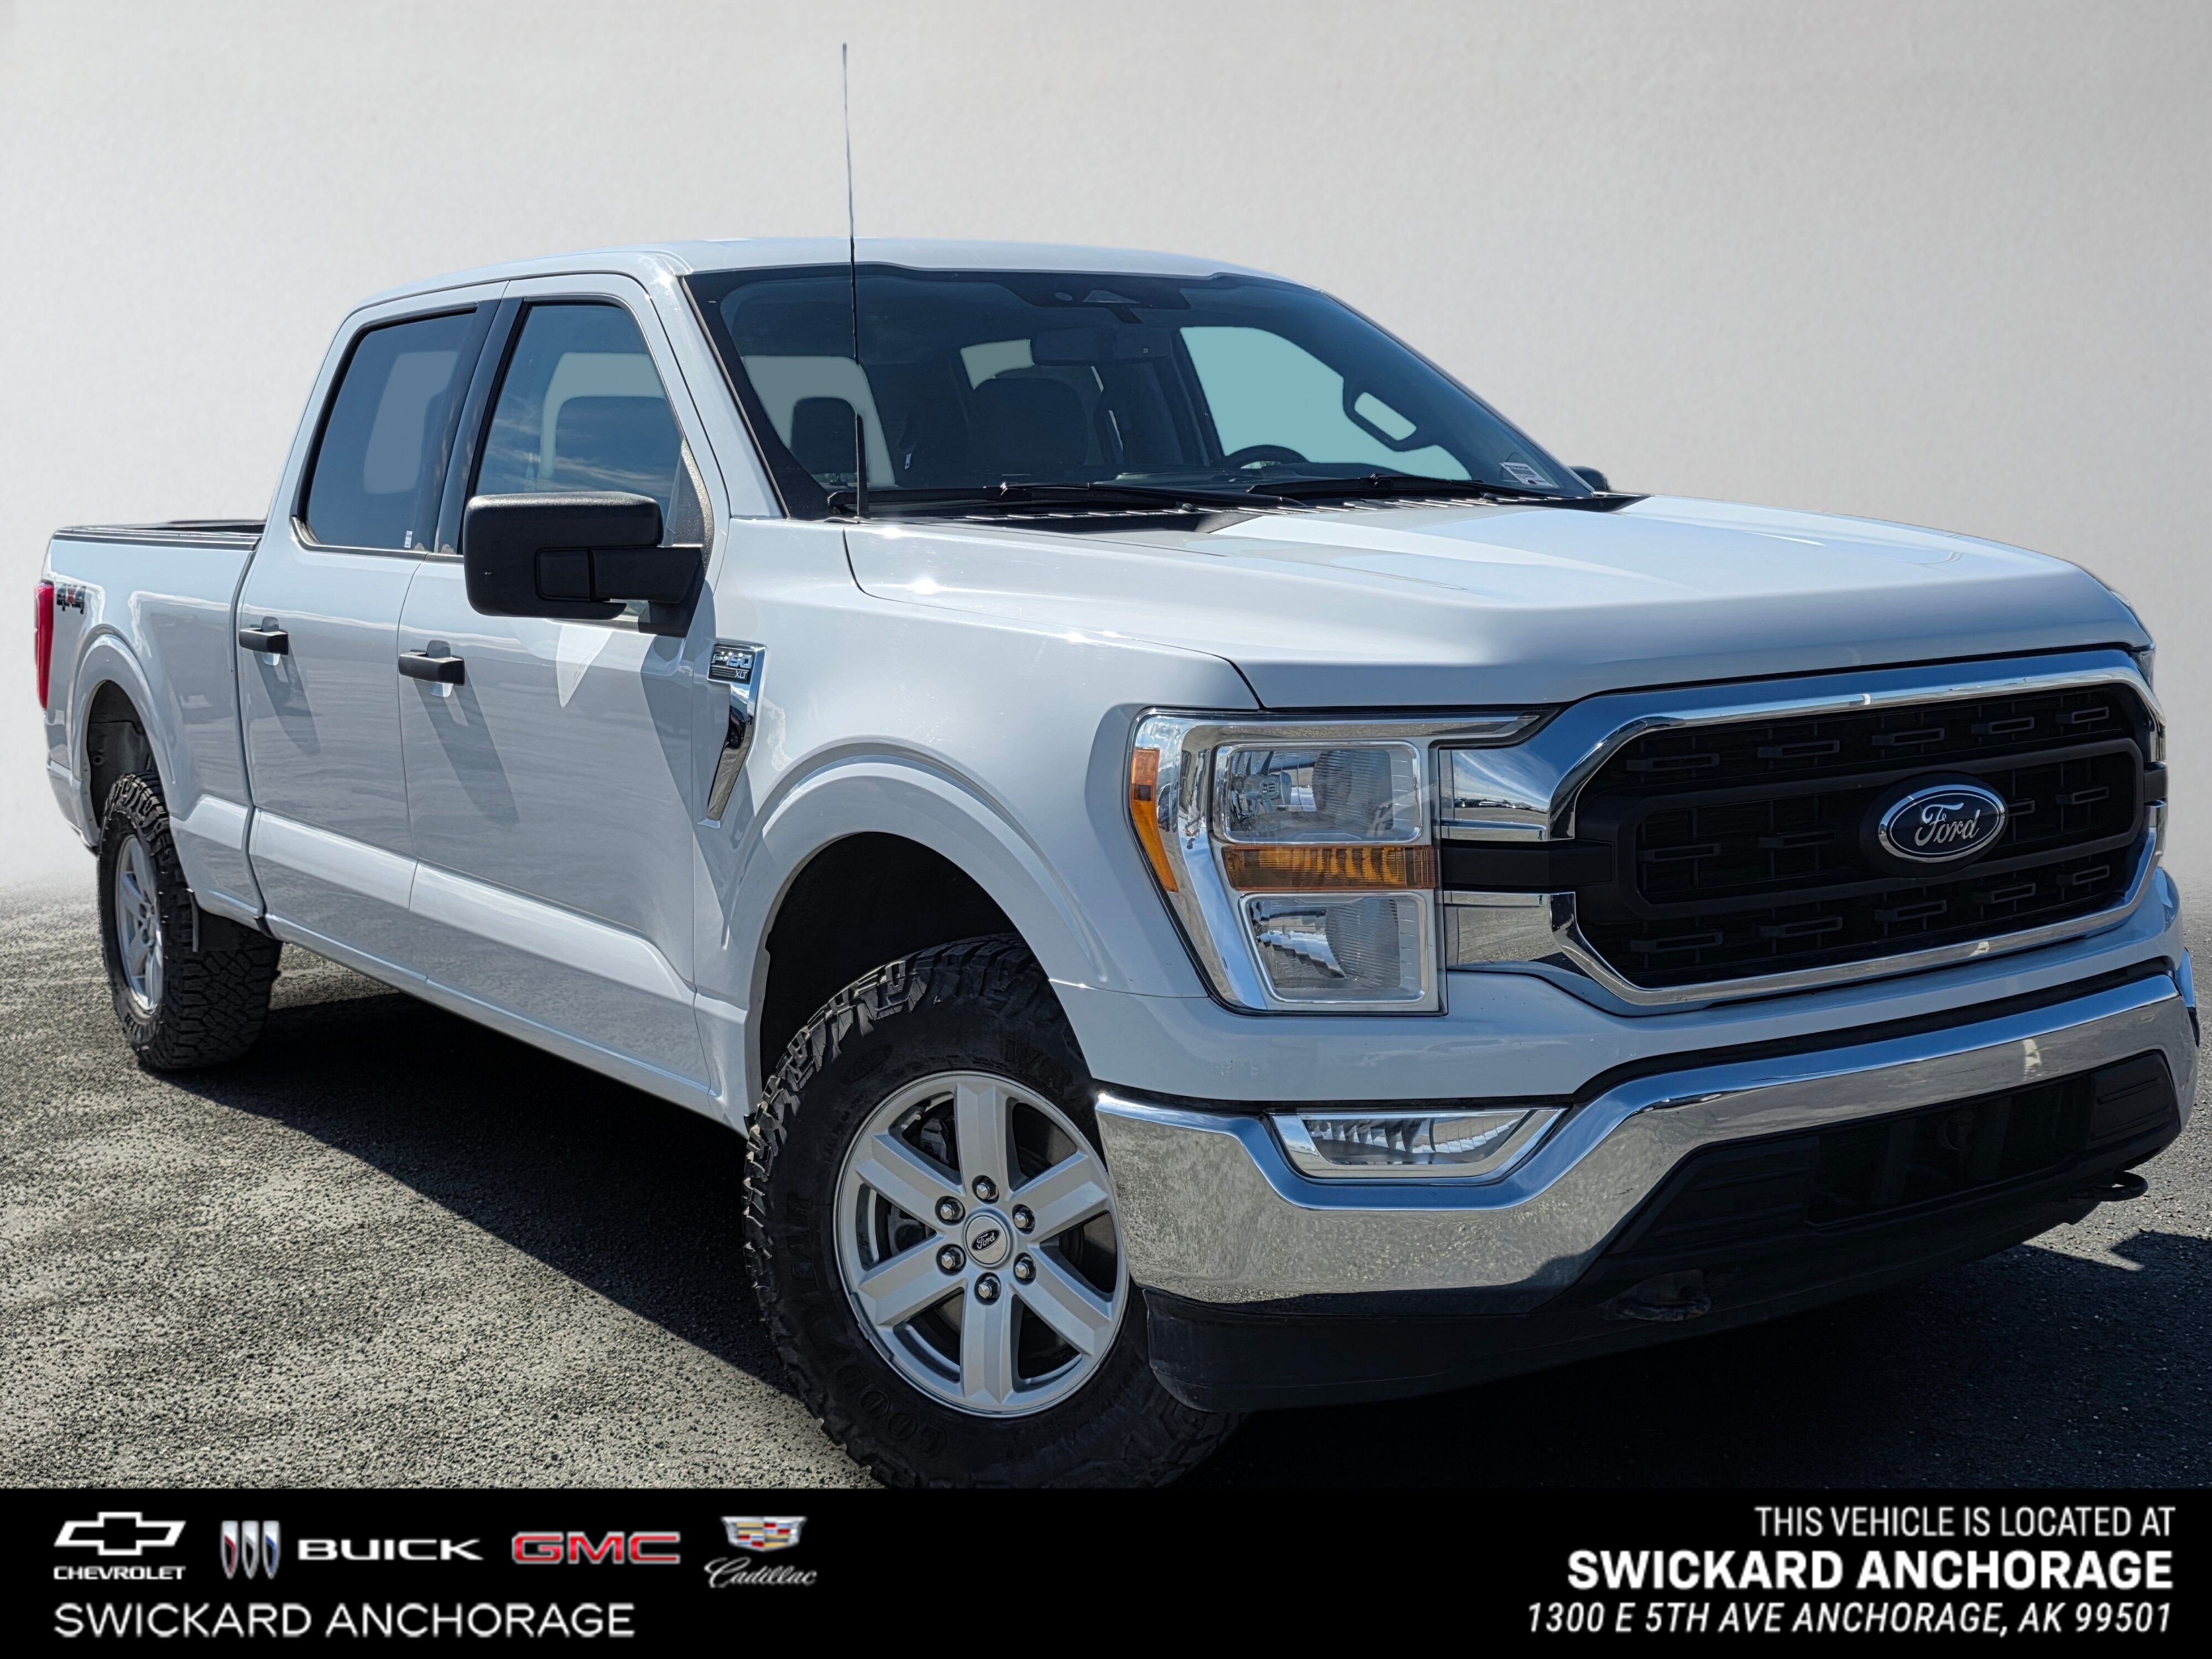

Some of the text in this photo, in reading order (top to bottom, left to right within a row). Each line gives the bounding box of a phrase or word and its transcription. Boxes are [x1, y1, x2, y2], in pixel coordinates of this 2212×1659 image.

[735, 670, 748, 679] XLT
[1914, 802, 1980, 846] Ford
[977, 1232, 996, 1249] Ford
